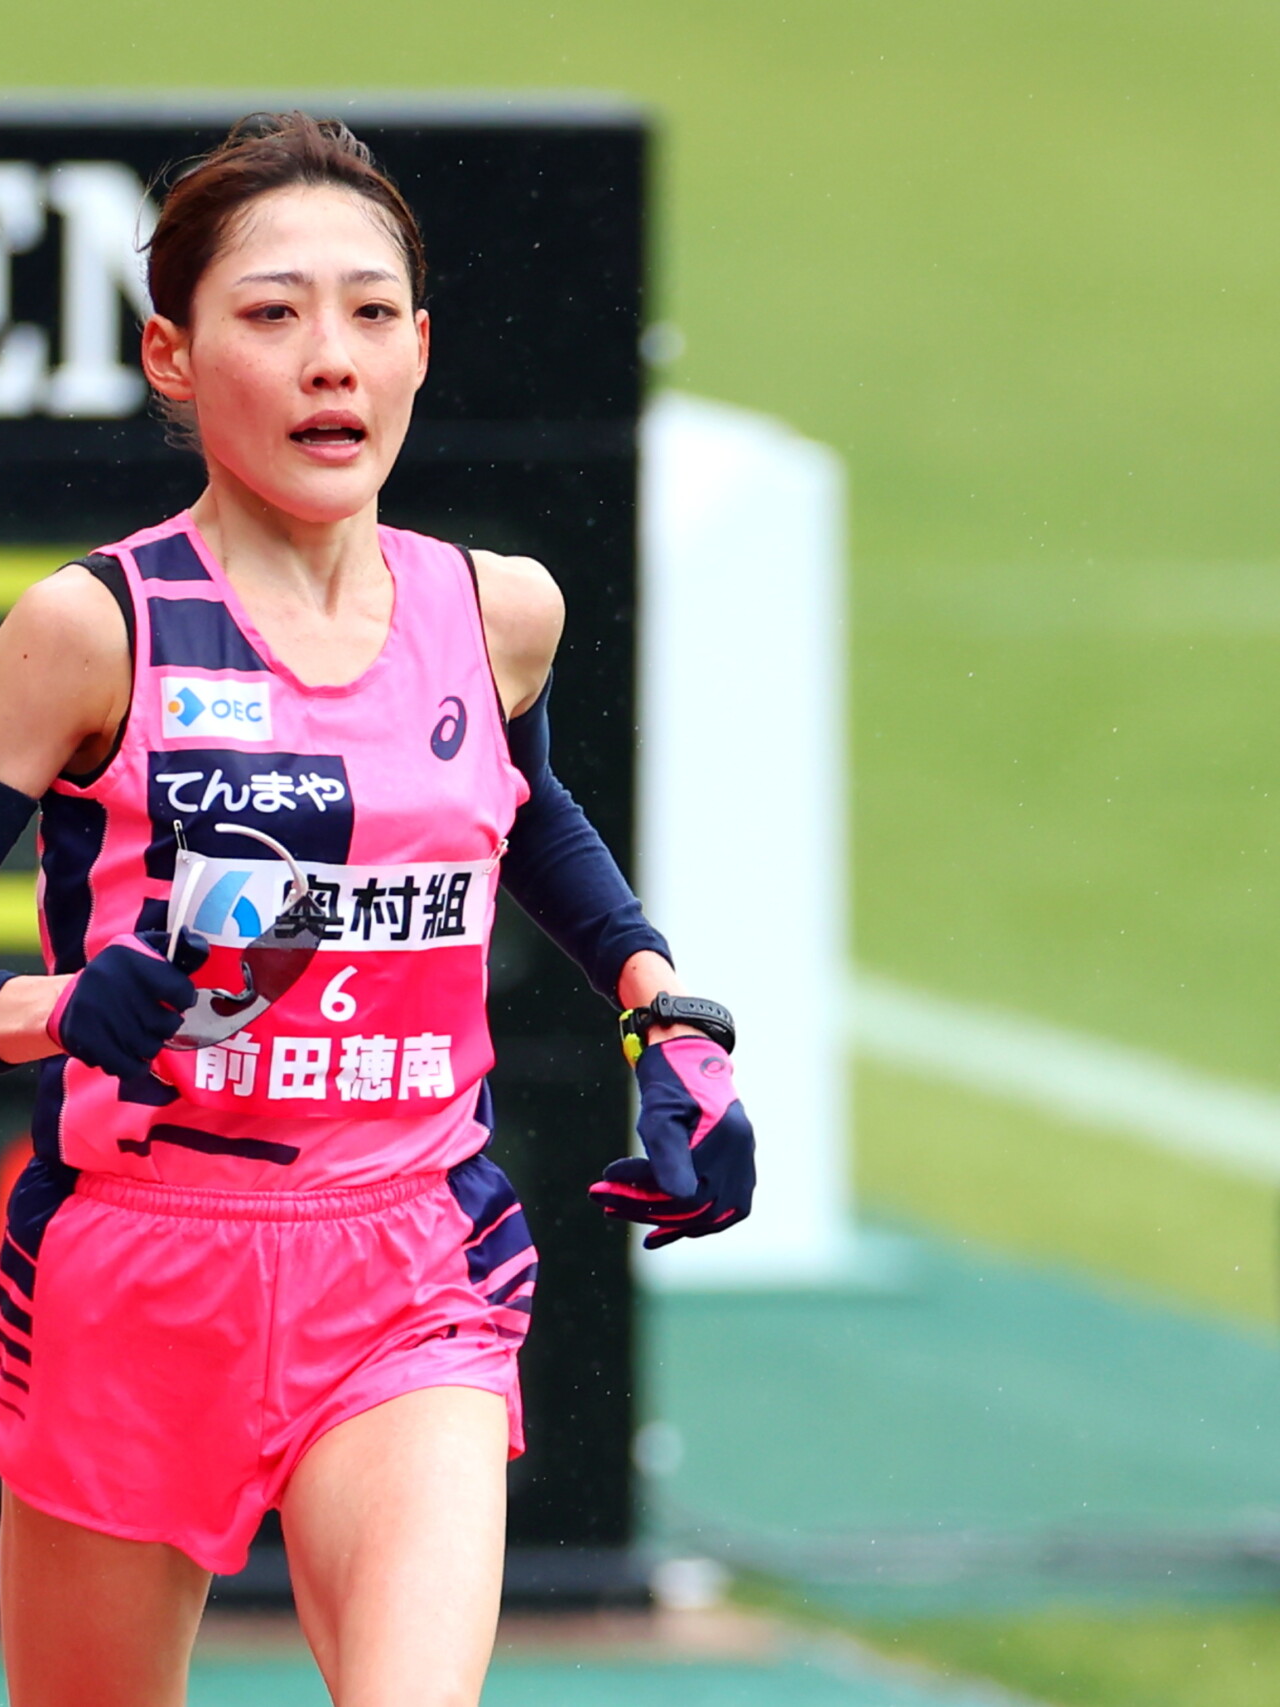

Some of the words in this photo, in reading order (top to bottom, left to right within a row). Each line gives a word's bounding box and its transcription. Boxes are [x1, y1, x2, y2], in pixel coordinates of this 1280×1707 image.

[211, 699, 263, 722] OEC
[155, 768, 346, 814] てんまや
[274, 871, 473, 942] 奥村組
[320, 965, 358, 1022] 6
[194, 1031, 456, 1101] 前田穂南
